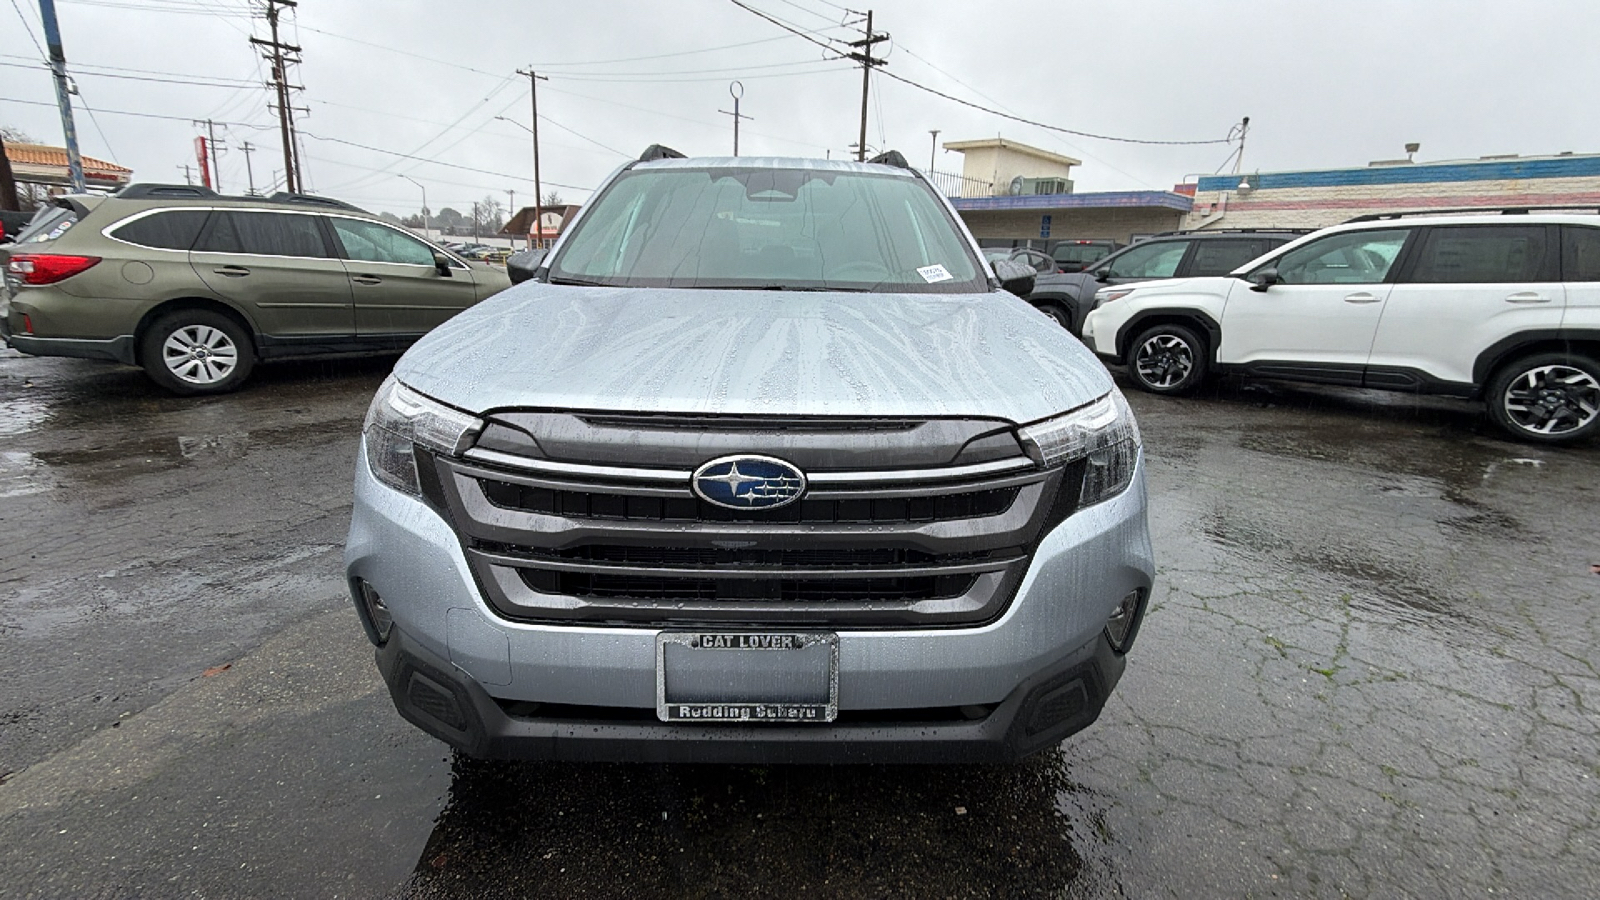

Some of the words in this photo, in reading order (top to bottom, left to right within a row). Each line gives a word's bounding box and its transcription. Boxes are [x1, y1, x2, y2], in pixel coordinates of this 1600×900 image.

[702, 635, 734, 648] CAT
[739, 635, 793, 648] LOVER
[679, 706, 750, 720] Redding
[755, 705, 815, 718] Subaru
